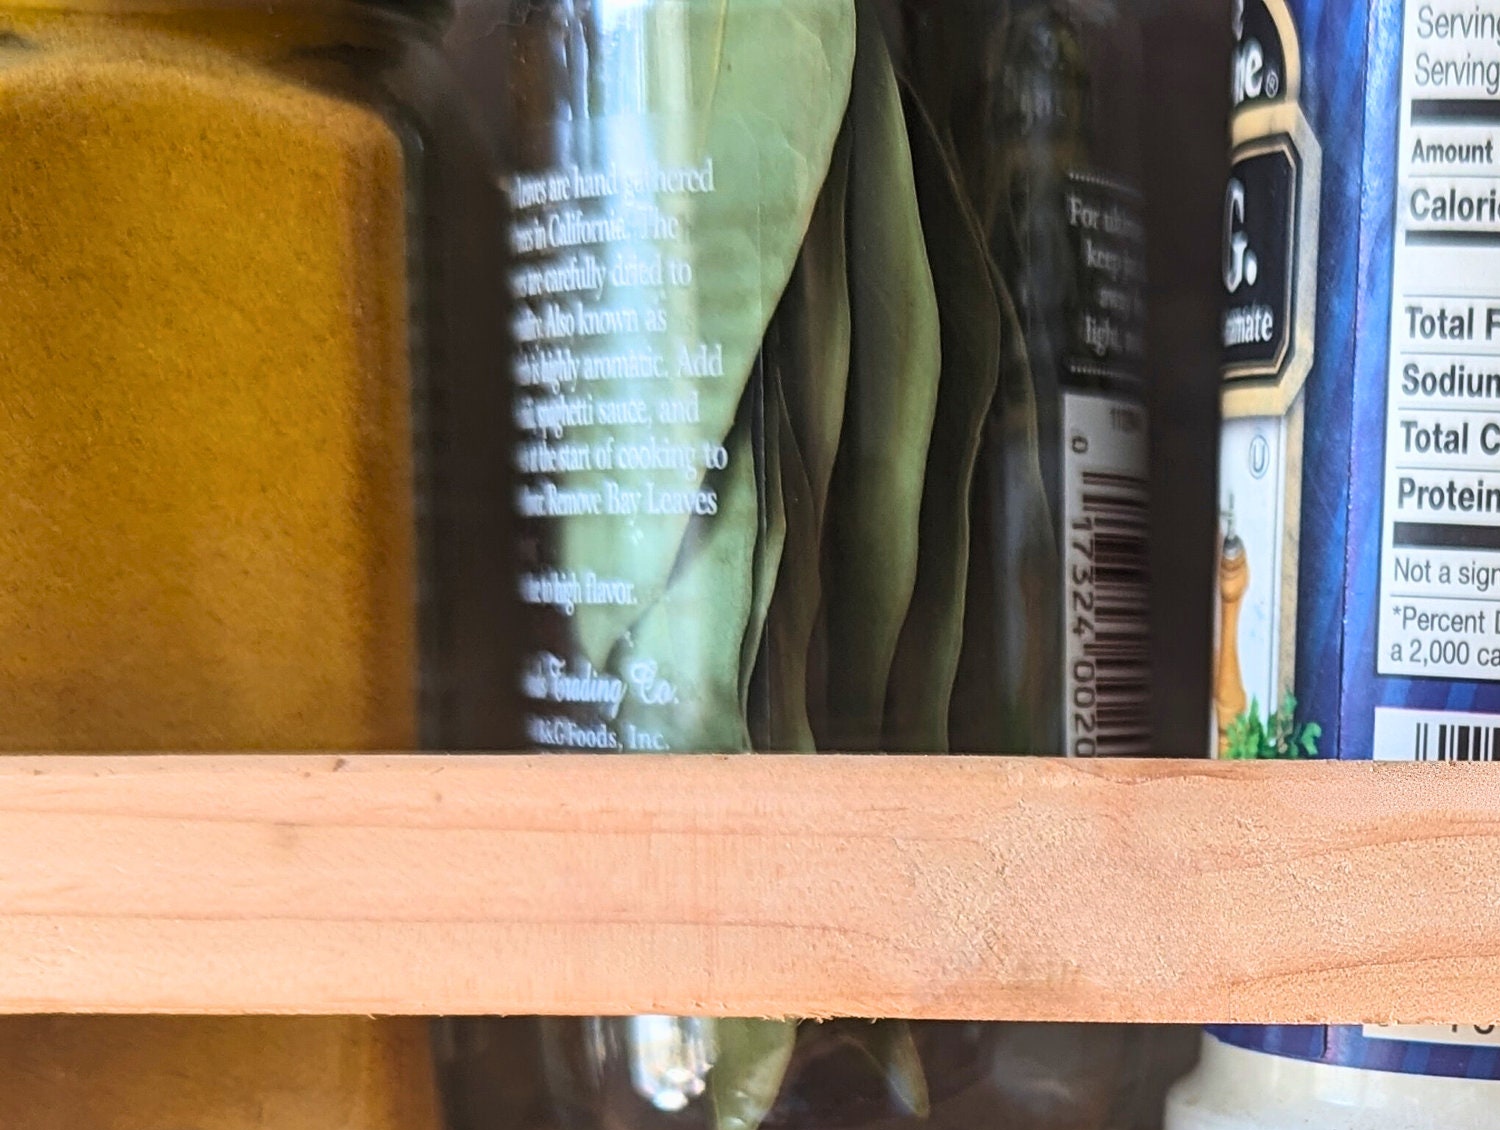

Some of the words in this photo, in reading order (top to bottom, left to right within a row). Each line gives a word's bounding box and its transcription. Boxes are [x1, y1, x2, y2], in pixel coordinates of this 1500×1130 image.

[1411, 139, 1492, 165] Amount
[549, 178, 571, 201] are
[574, 165, 617, 198] hand
[550, 210, 630, 248] California.
[544, 255, 607, 300] carefully
[611, 253, 663, 288] dried
[669, 257, 693, 286] to
[546, 302, 575, 338] Also
[578, 301, 640, 336] known
[645, 308, 667, 332] as
[1405, 307, 1474, 340] Total
[583, 350, 669, 381] aromatic.
[678, 343, 724, 378] Add
[597, 400, 652, 426] sauce,
[659, 391, 701, 424] and
[1400, 420, 1469, 454] Total
[595, 436, 615, 471] of
[616, 437, 698, 481] cooking
[705, 442, 728, 471] to
[605, 481, 642, 526] Bay
[647, 482, 718, 516] Leaves
[1071, 517, 1094, 636] 17324
[1394, 557, 1431, 584] Not
[1439, 564, 1451, 584] a
[586, 573, 638, 605] flavor.
[1391, 644, 1402, 662] a
[1409, 639, 1469, 667] 2,000
[630, 658, 679, 704] Co.
[567, 721, 624, 753] Foods,
[627, 722, 671, 750] Inc.
